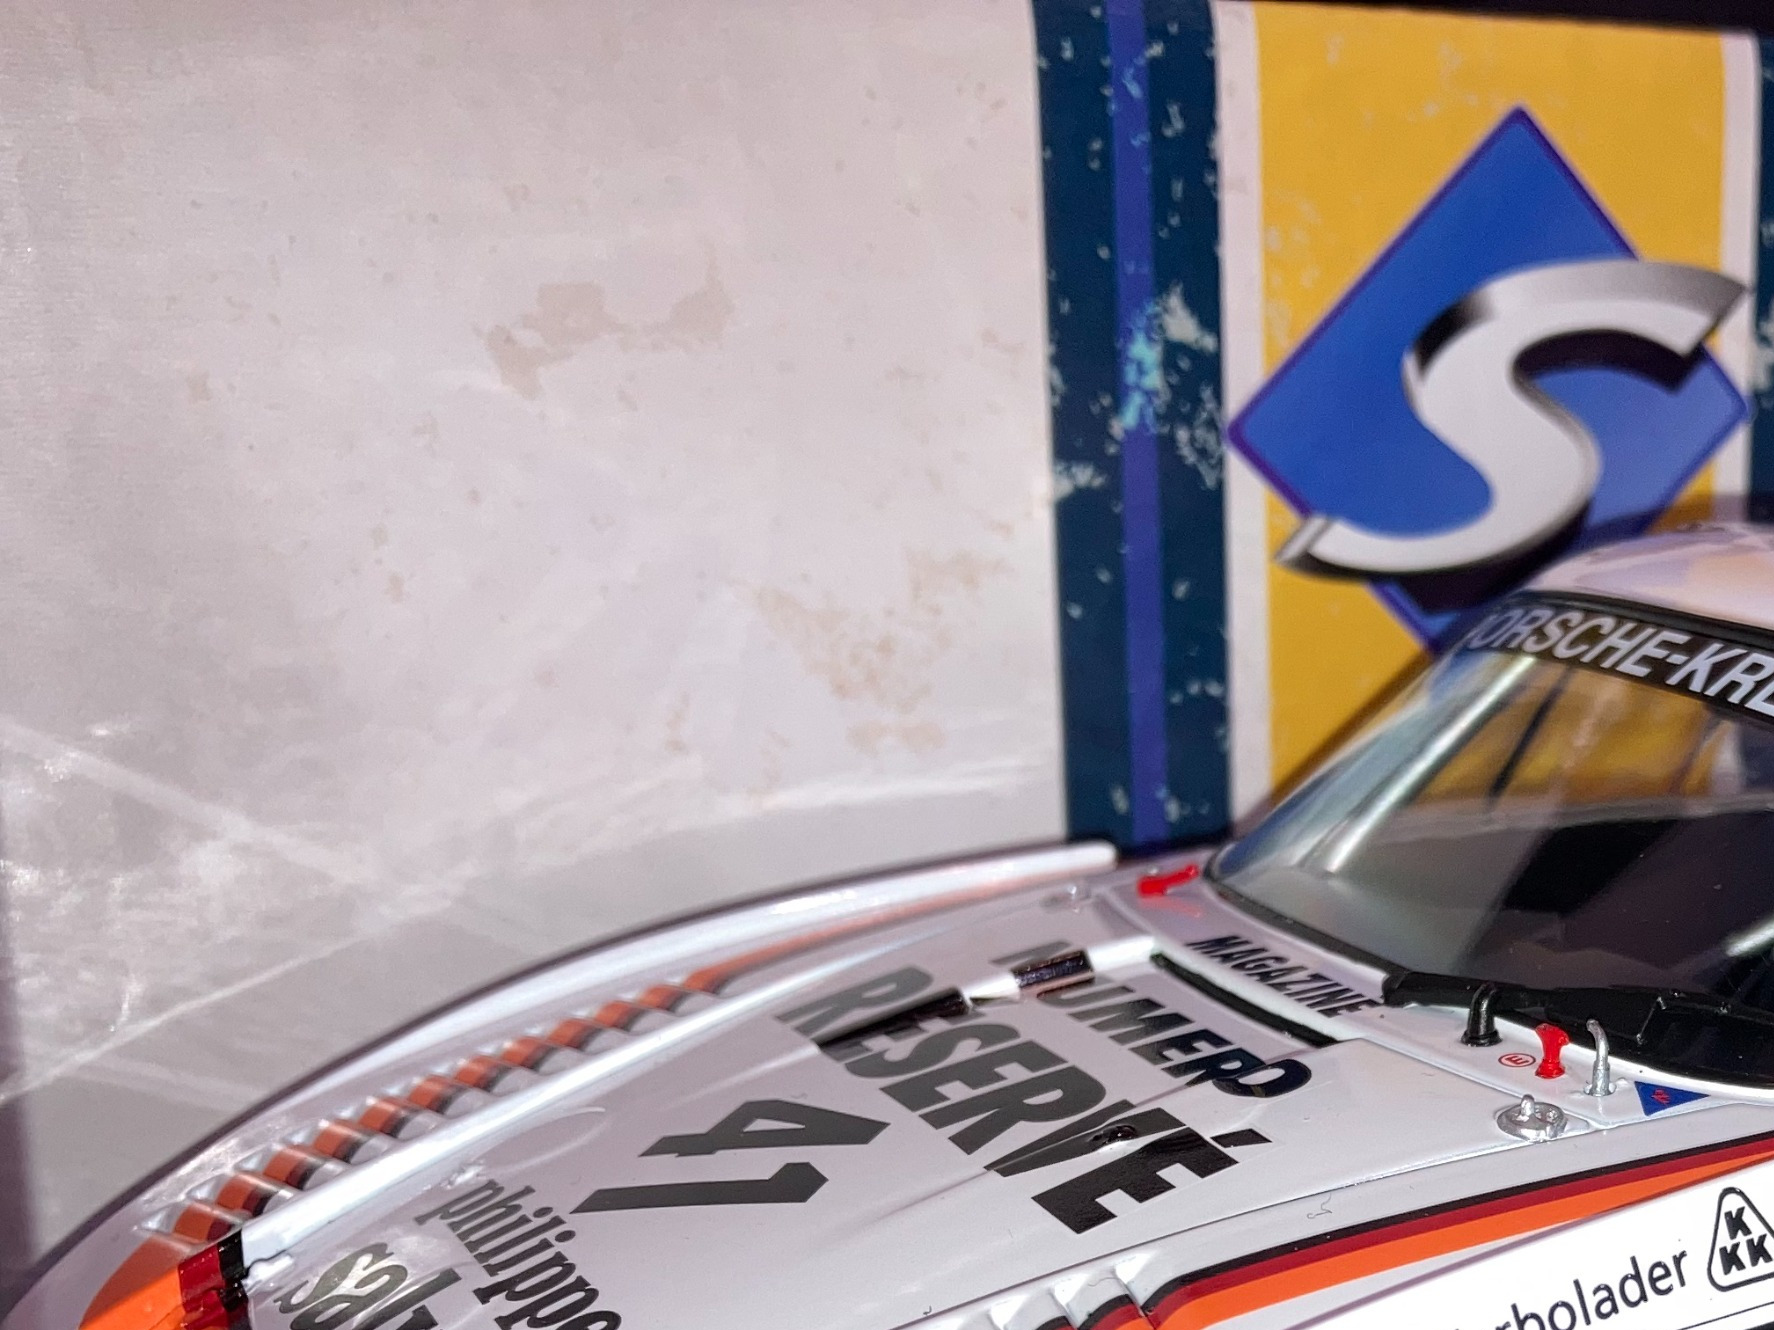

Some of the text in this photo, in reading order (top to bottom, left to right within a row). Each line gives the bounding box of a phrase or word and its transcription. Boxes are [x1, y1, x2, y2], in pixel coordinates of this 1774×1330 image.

[1184, 935, 1382, 1019] MAGAZINE
[568, 1100, 892, 1214] 41
[1719, 1233, 1773, 1276] KK
[1724, 1206, 1752, 1241] K
